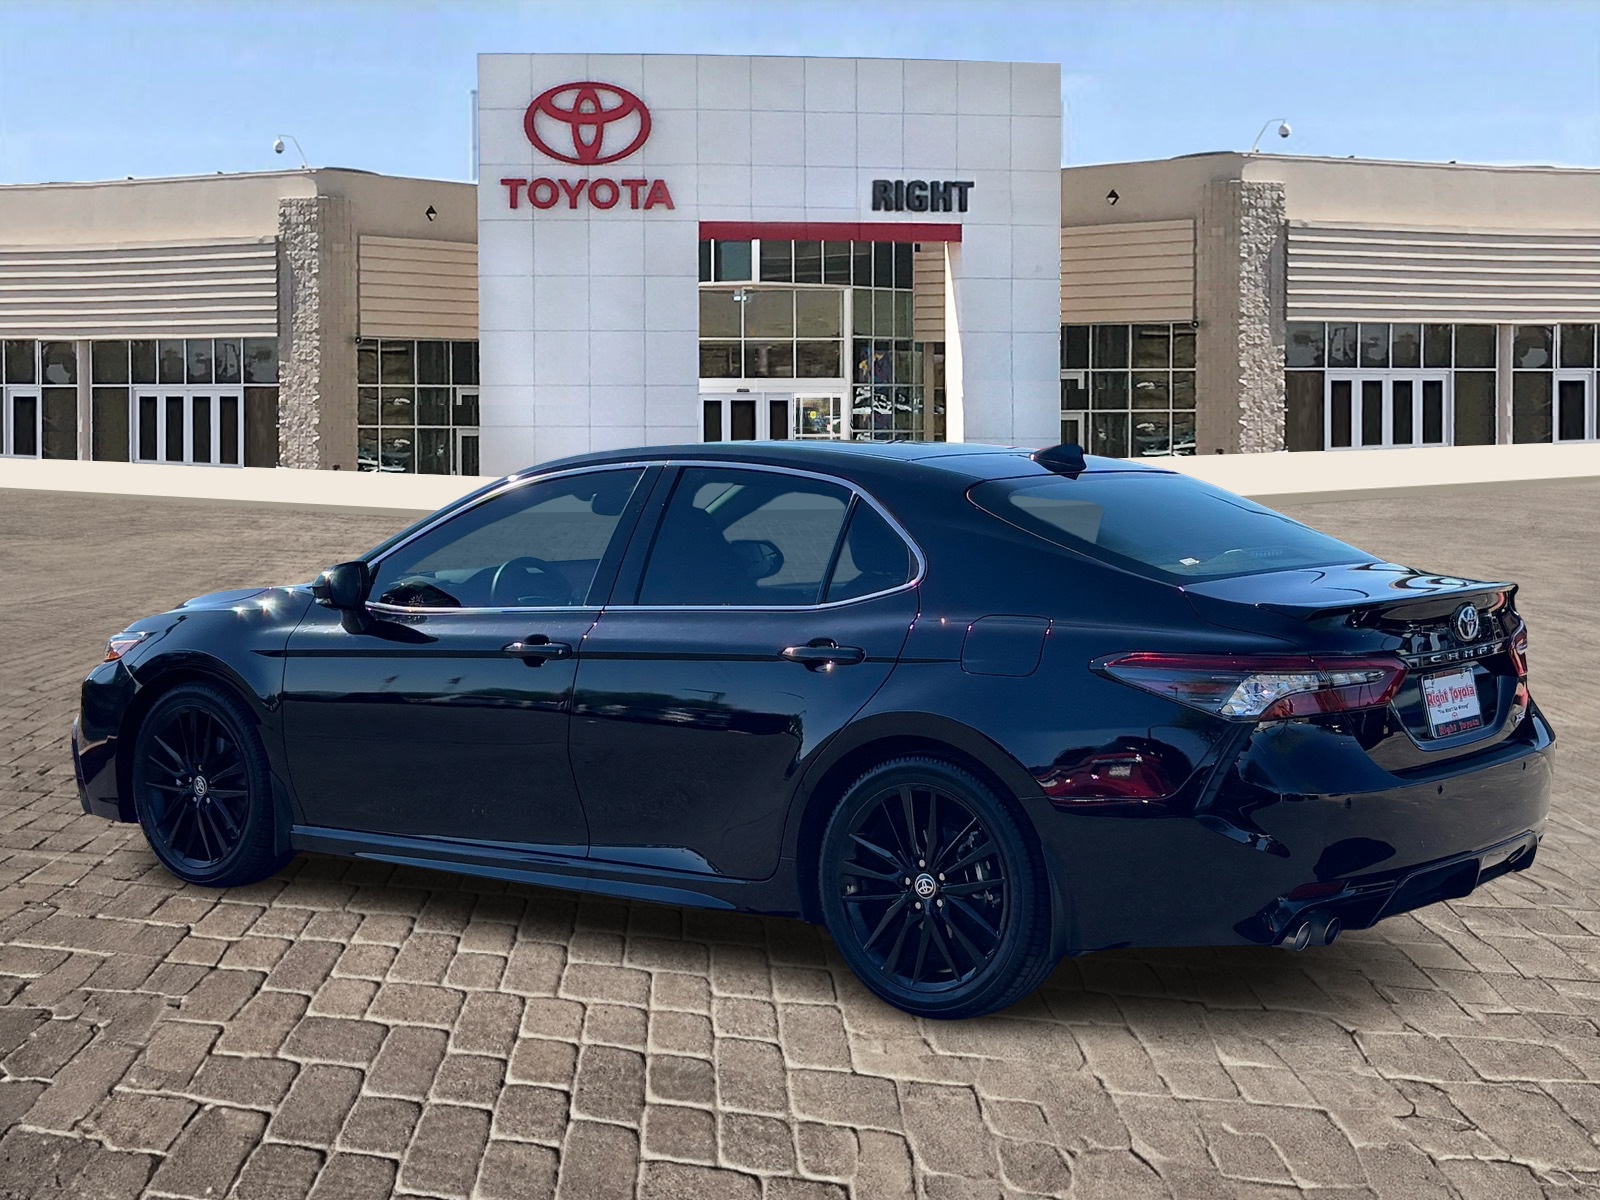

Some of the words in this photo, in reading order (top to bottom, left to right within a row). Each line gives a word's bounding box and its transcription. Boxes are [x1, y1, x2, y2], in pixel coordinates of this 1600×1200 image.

[500, 178, 675, 210] TOYOTA
[872, 179, 975, 213] RIGHT
[1426, 689, 1449, 708] Right
[1449, 684, 1475, 703] Toyota
